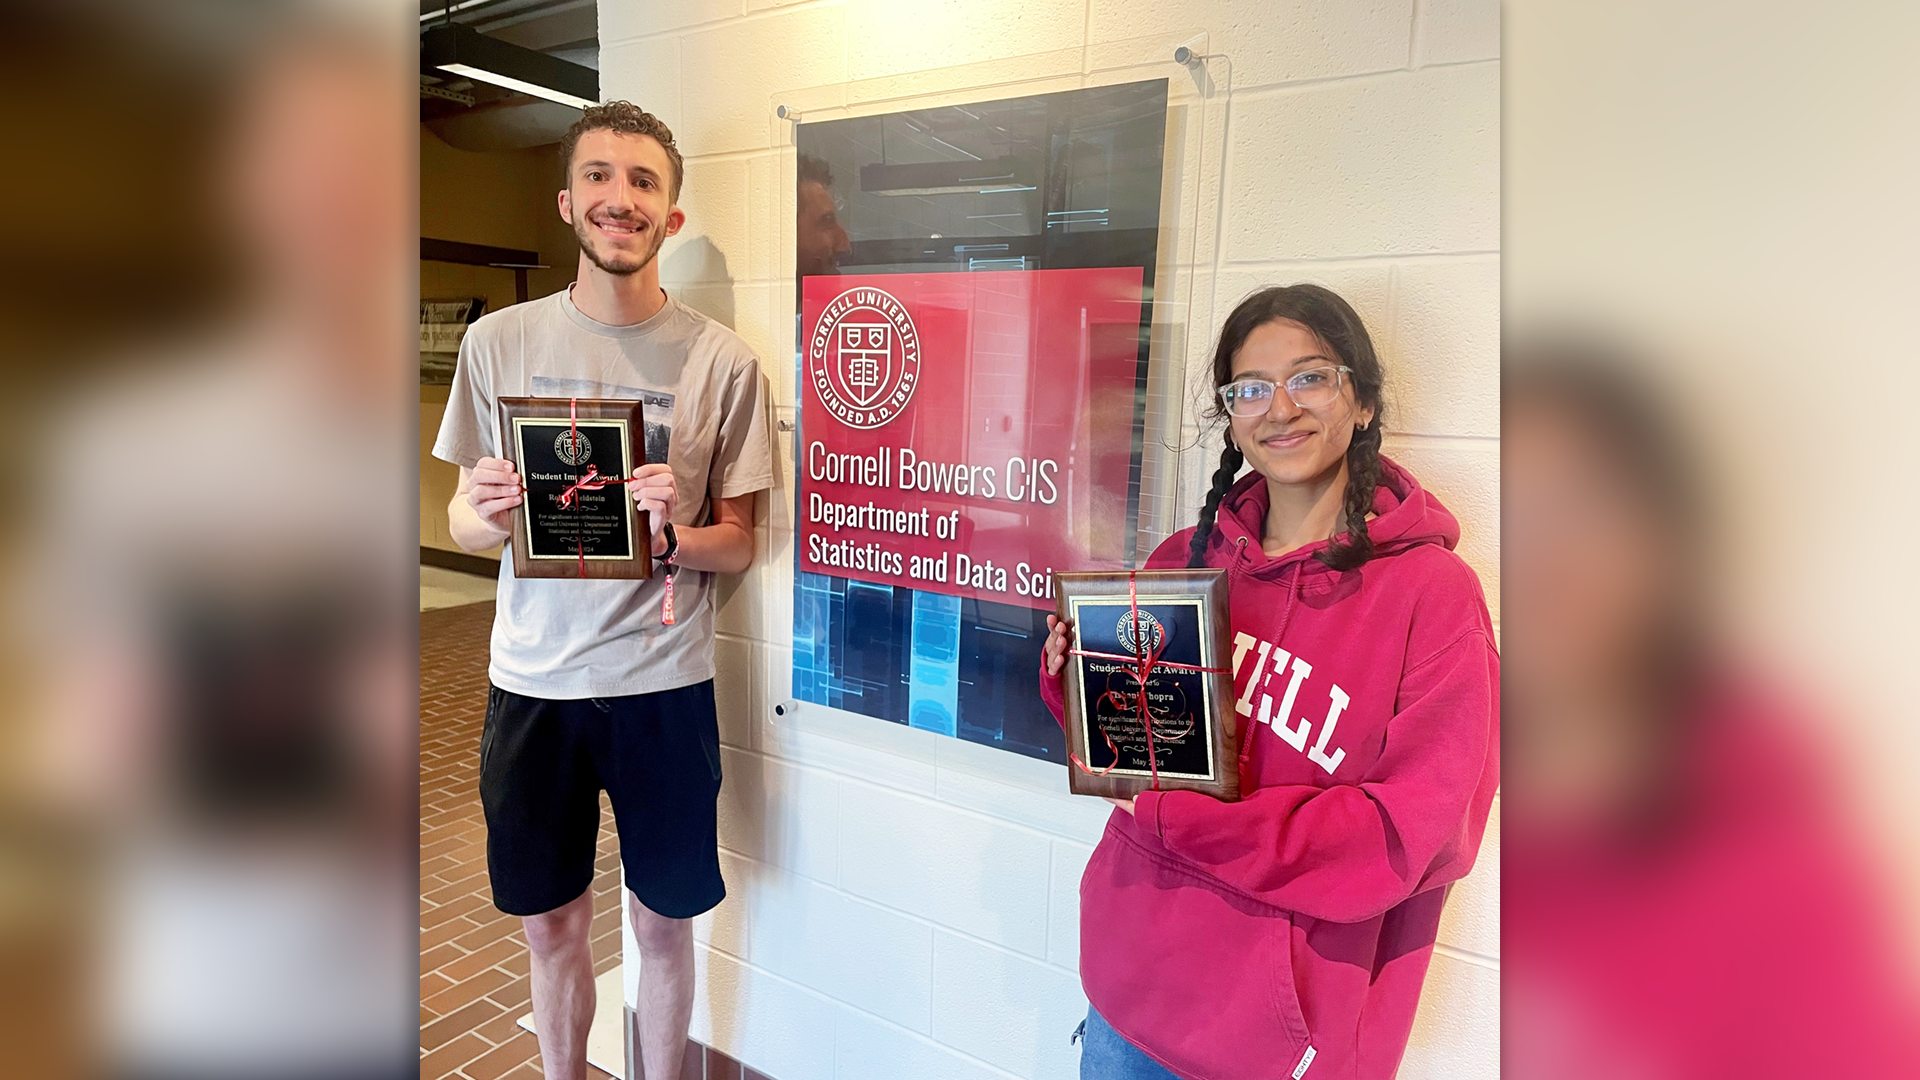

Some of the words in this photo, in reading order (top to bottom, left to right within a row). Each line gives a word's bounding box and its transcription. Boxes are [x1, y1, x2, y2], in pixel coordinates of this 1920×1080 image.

[812, 296, 854, 360] CORNELL
[855, 291, 918, 364] UNIVERSITY
[814, 369, 863, 425] FOUNDED
[867, 408, 893, 425] A.D.
[891, 372, 914, 409] 1865
[531, 472, 562, 481] Student
[809, 440, 891, 488] Cornell
[898, 447, 996, 499] Bowers
[578, 494, 606, 503] eldstein
[809, 492, 930, 539] Department
[936, 509, 959, 541] of
[808, 532, 903, 576] Statistics
[909, 551, 948, 583] and
[955, 554, 1008, 594] Data
[1016, 563, 1056, 601] Sci
[1146, 692, 1175, 703] hopra
[1132, 758, 1147, 767] May
[1148, 758, 1164, 767] 224
